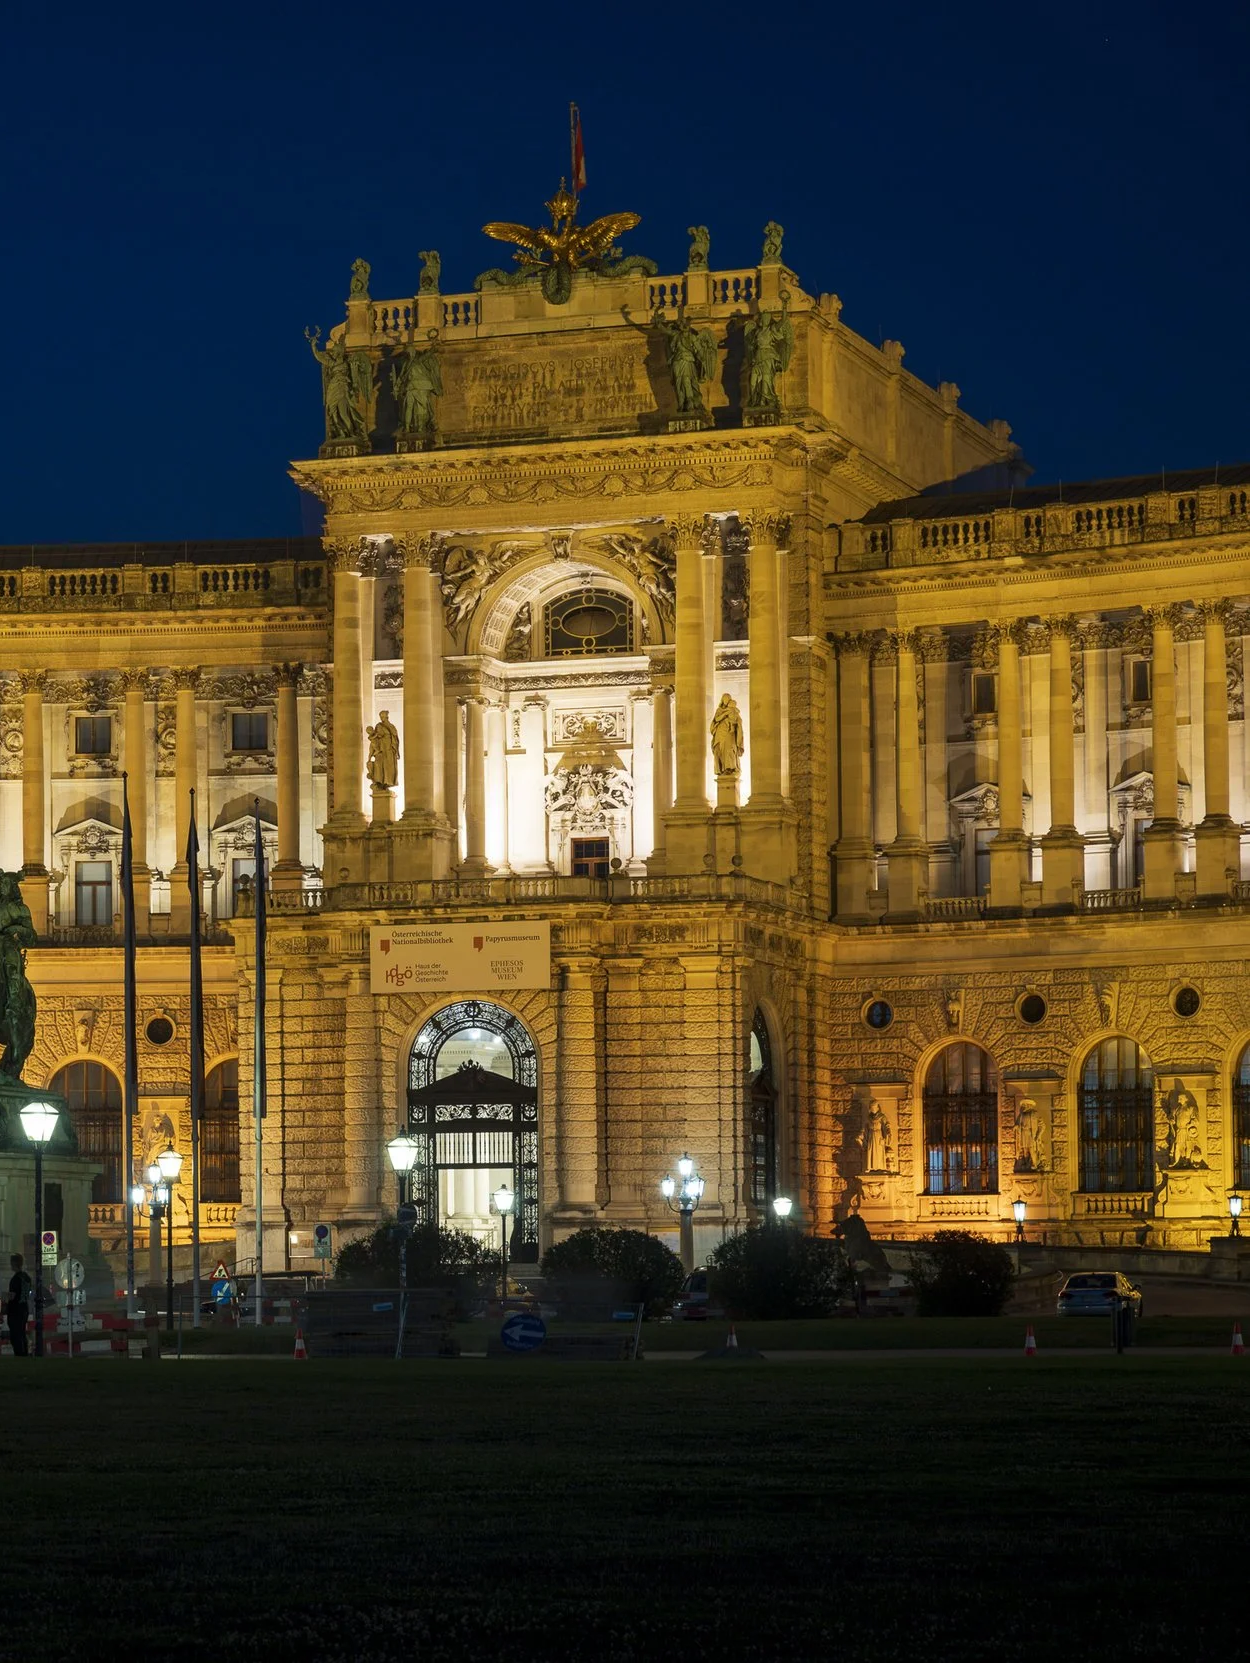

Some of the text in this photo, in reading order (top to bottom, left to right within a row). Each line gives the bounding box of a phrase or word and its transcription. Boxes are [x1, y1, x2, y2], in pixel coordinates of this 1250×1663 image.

[391, 930, 443, 938] Österreichische
[391, 937, 454, 945] Nationalbibliothek
[485, 935, 540, 944] Papyrusmuseum
